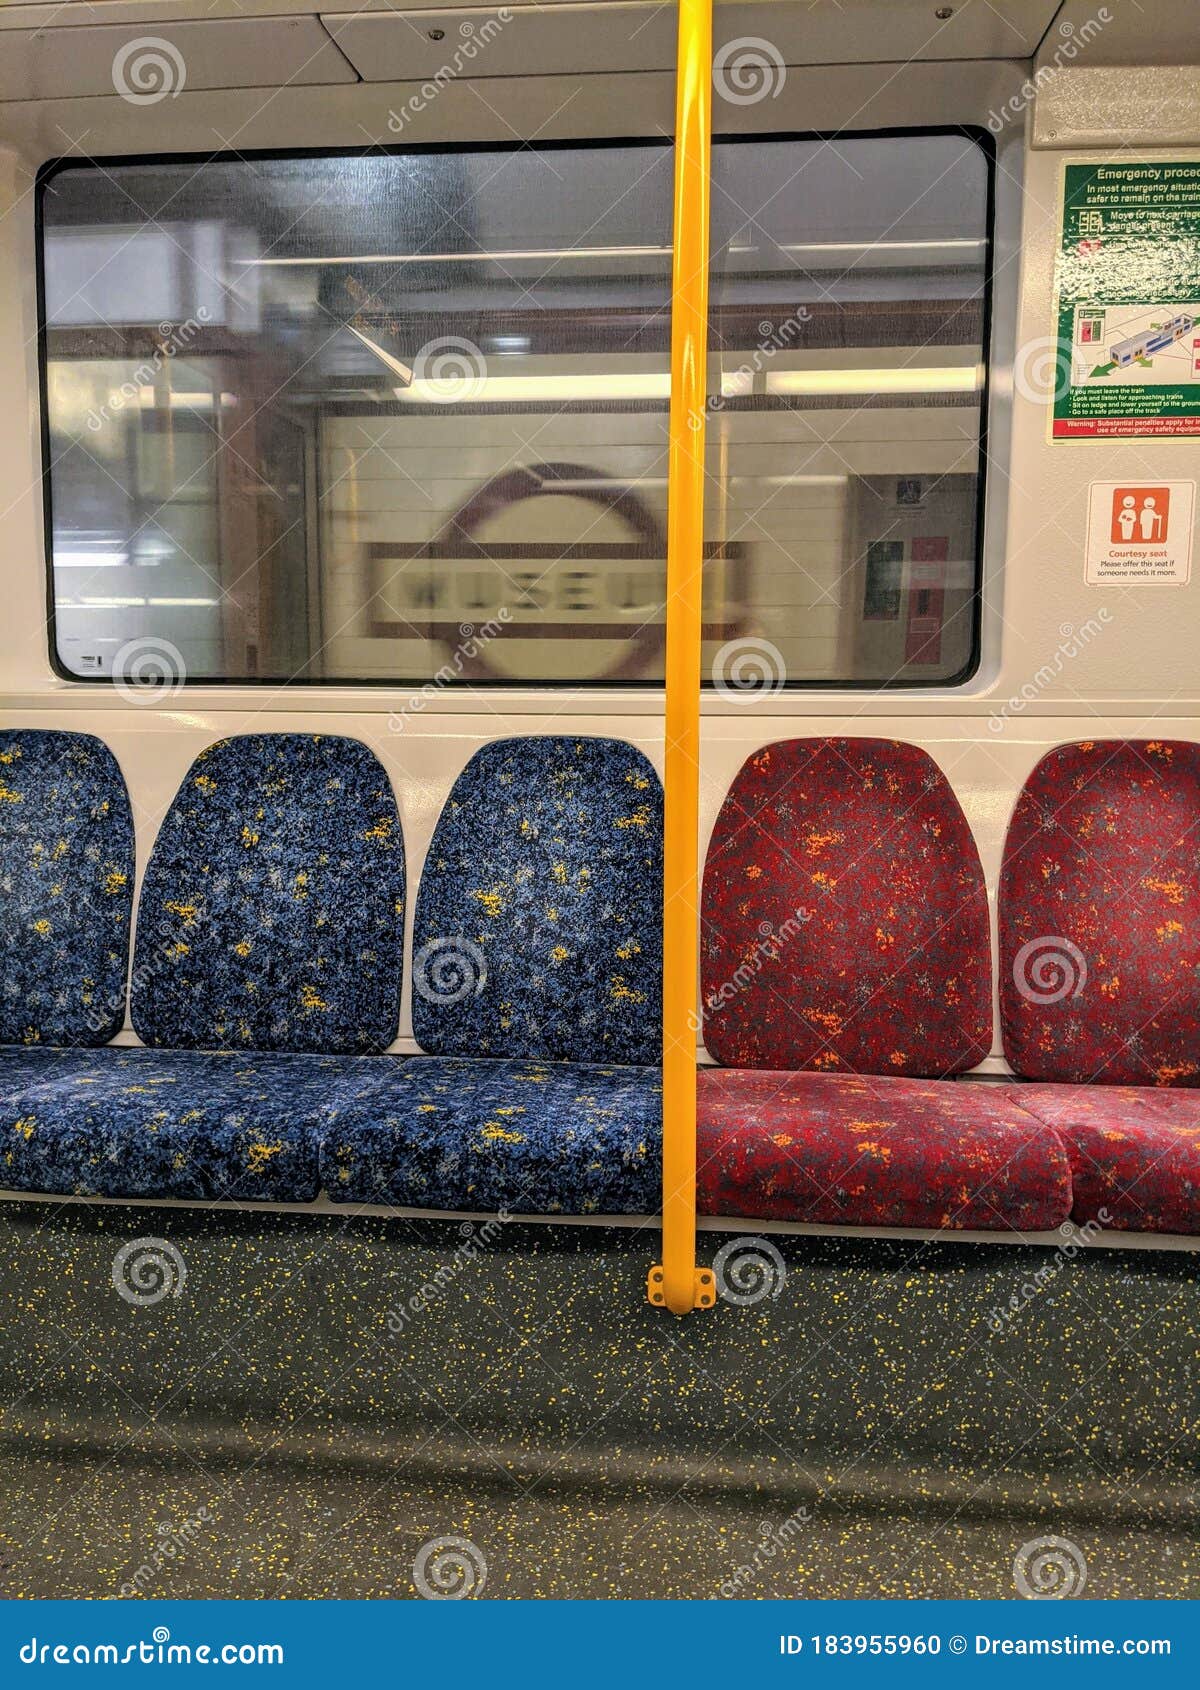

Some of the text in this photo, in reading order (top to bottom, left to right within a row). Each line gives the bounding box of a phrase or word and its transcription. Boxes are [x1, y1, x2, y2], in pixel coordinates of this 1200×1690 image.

[1097, 169, 1161, 180] Emergency
[1087, 185, 1095, 193] In
[1097, 184, 1119, 193] most
[1121, 184, 1169, 193] emergency
[1086, 195, 1108, 203] safer
[1110, 194, 1119, 202] to
[1121, 193, 1150, 203] remain
[1152, 194, 1164, 203] on
[1166, 193, 1180, 201] the
[1110, 211, 1134, 220] Move
[1136, 210, 1146, 219] to
[1147, 210, 1165, 219] next
[1128, 394, 1165, 402] approaching
[1134, 420, 1164, 428] penalties
[1165, 419, 1183, 427] apply
[1108, 550, 1147, 559] Courtesy
